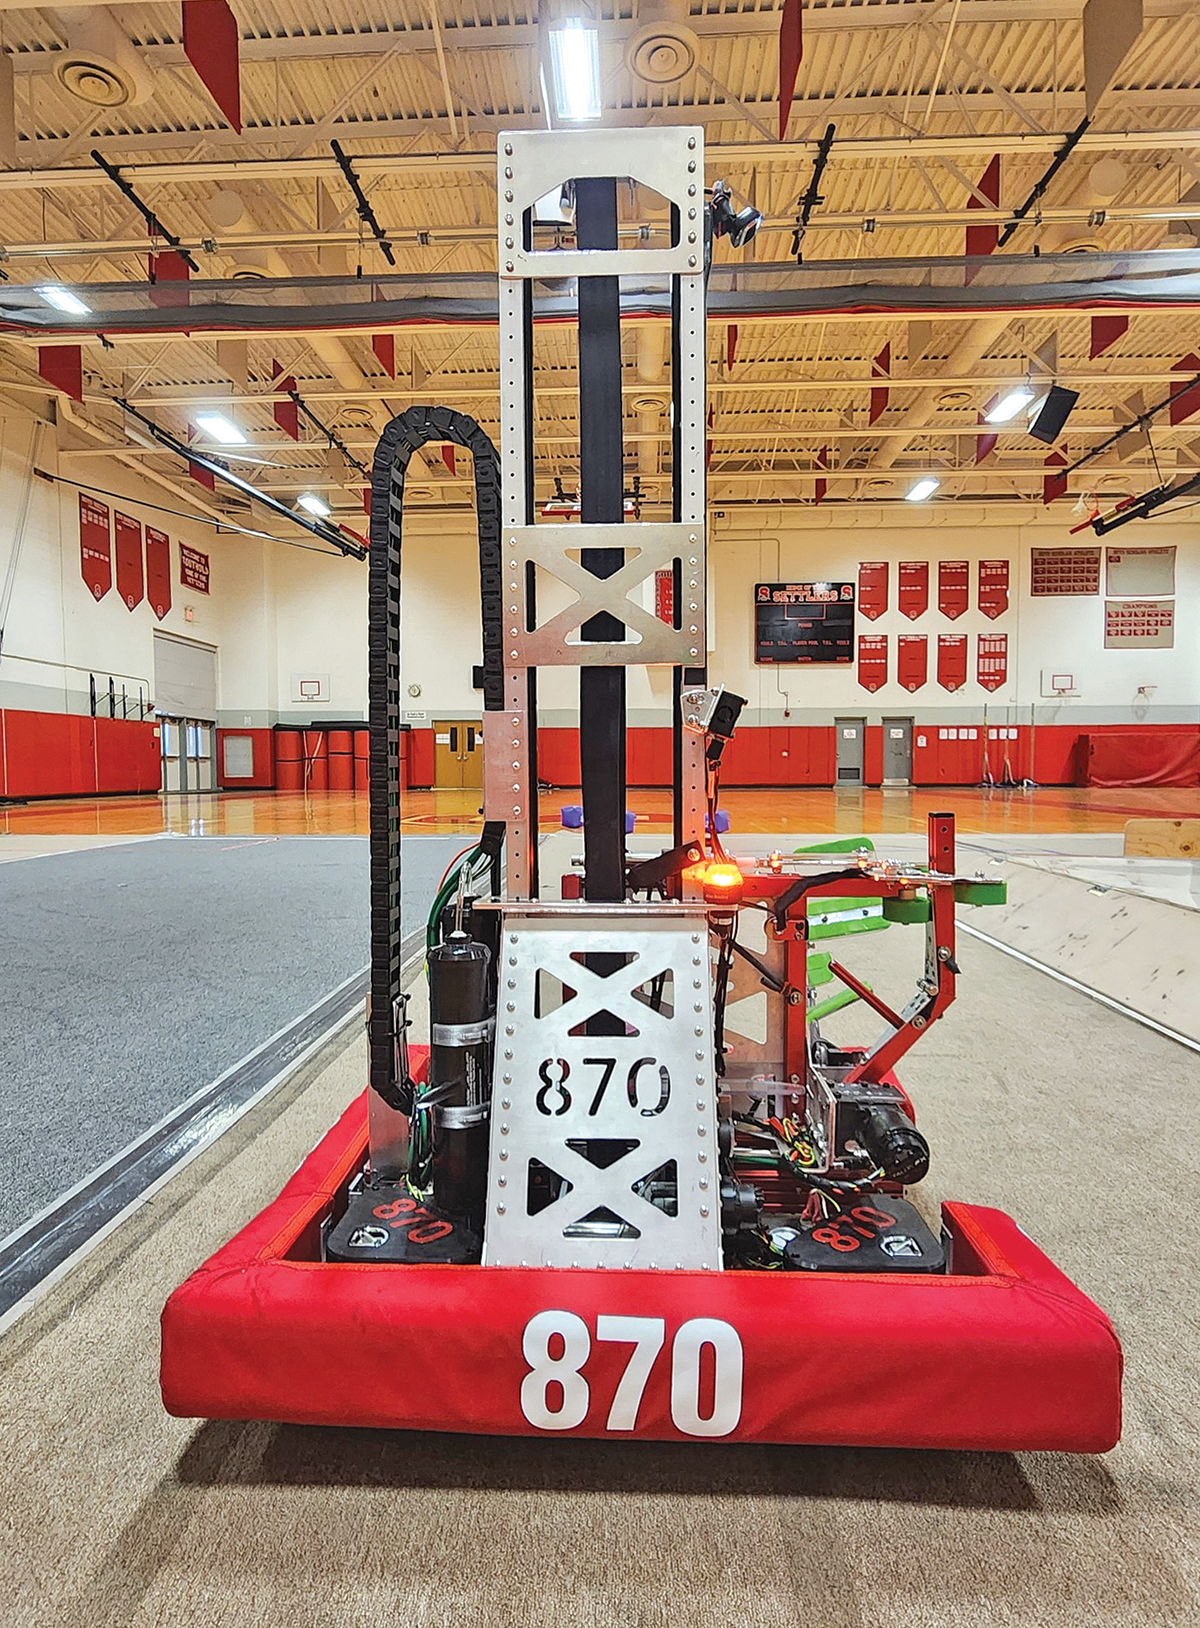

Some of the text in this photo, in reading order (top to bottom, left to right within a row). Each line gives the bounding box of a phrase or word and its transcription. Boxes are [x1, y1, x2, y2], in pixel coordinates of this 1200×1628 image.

[772, 590, 839, 602] SETTLERS
[535, 1057, 671, 1117] 870
[372, 1198, 454, 1244] 870
[811, 1206, 898, 1252] 870
[520, 1309, 745, 1437] 870
